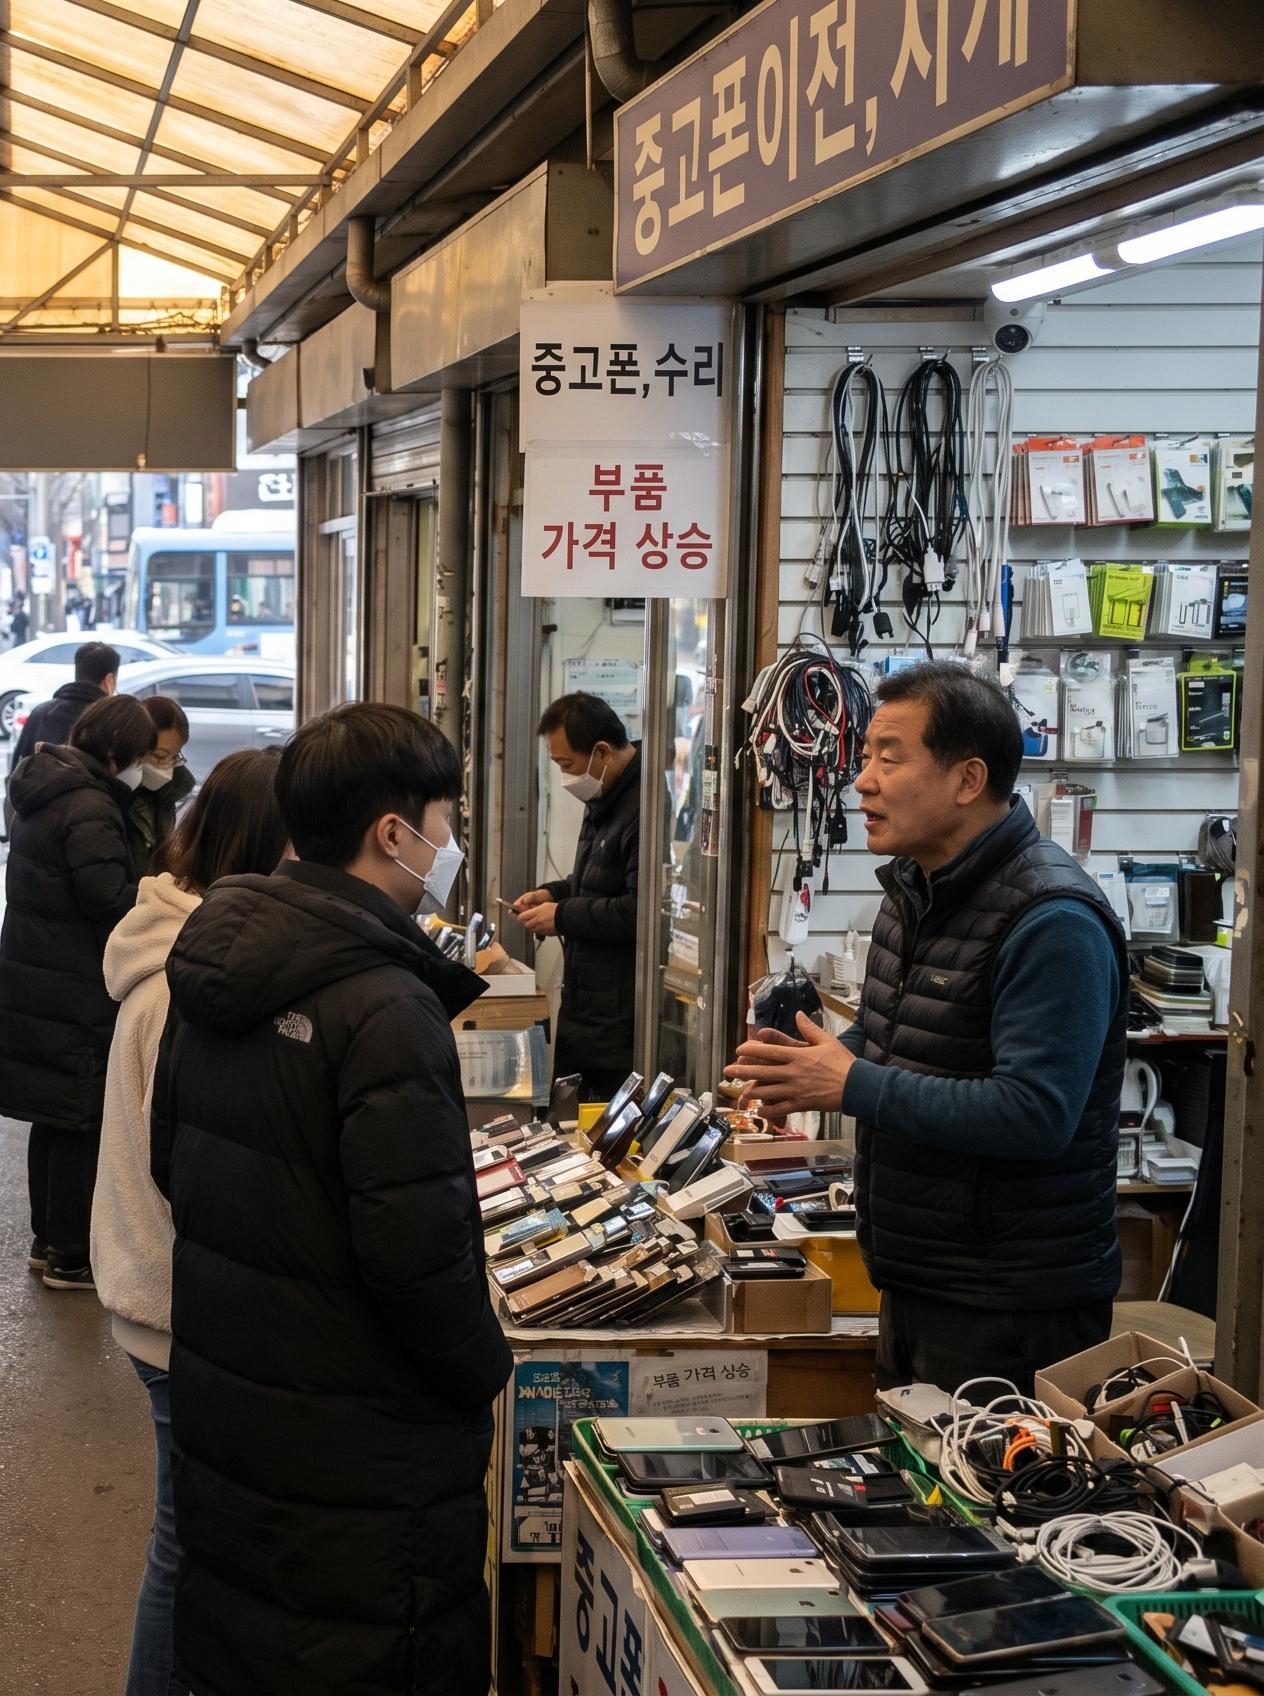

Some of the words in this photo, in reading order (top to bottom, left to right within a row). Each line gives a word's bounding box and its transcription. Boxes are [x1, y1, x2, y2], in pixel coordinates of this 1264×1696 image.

[531, 342, 724, 399] 중고폰,수리
[589, 464, 667, 512] 부품
[541, 522, 617, 570] 가격
[635, 522, 713, 570] 상승
[653, 1372, 680, 1389] 부품
[683, 1365, 716, 1382] 가격
